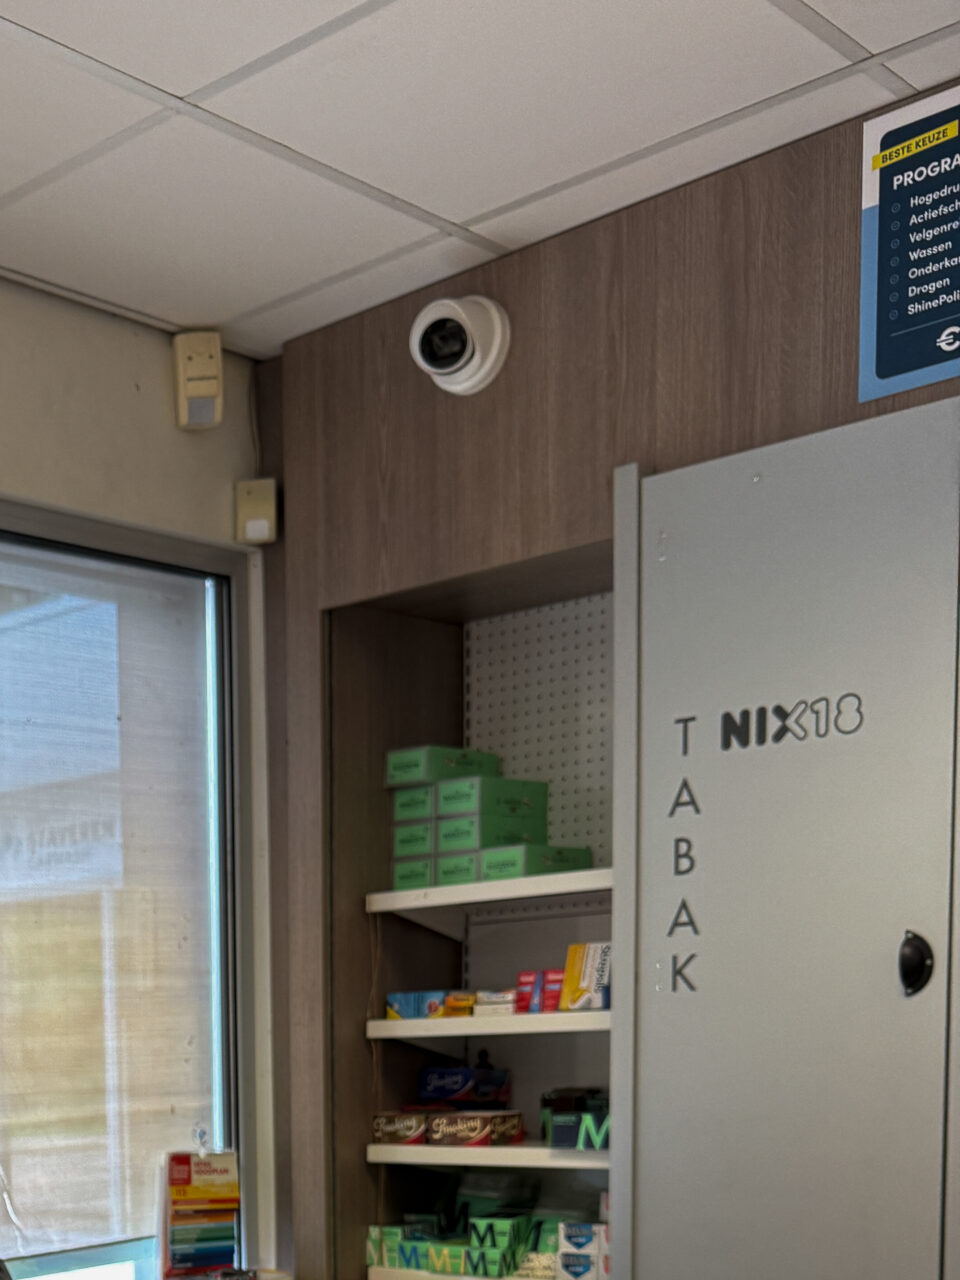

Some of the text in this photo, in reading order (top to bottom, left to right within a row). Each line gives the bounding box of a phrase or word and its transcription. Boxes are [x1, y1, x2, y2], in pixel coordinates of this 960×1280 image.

[881, 128, 948, 164] BESTE KEUZE
[909, 217, 960, 243] Velgenre
[908, 241, 952, 261] Wassen
[908, 277, 950, 297] Drogen
[907, 288, 960, 315] ShinePoli
[721, 693, 863, 751] NIX18
[667, 715, 701, 993] TABAK
[431, 1117, 483, 1140] Smoking
